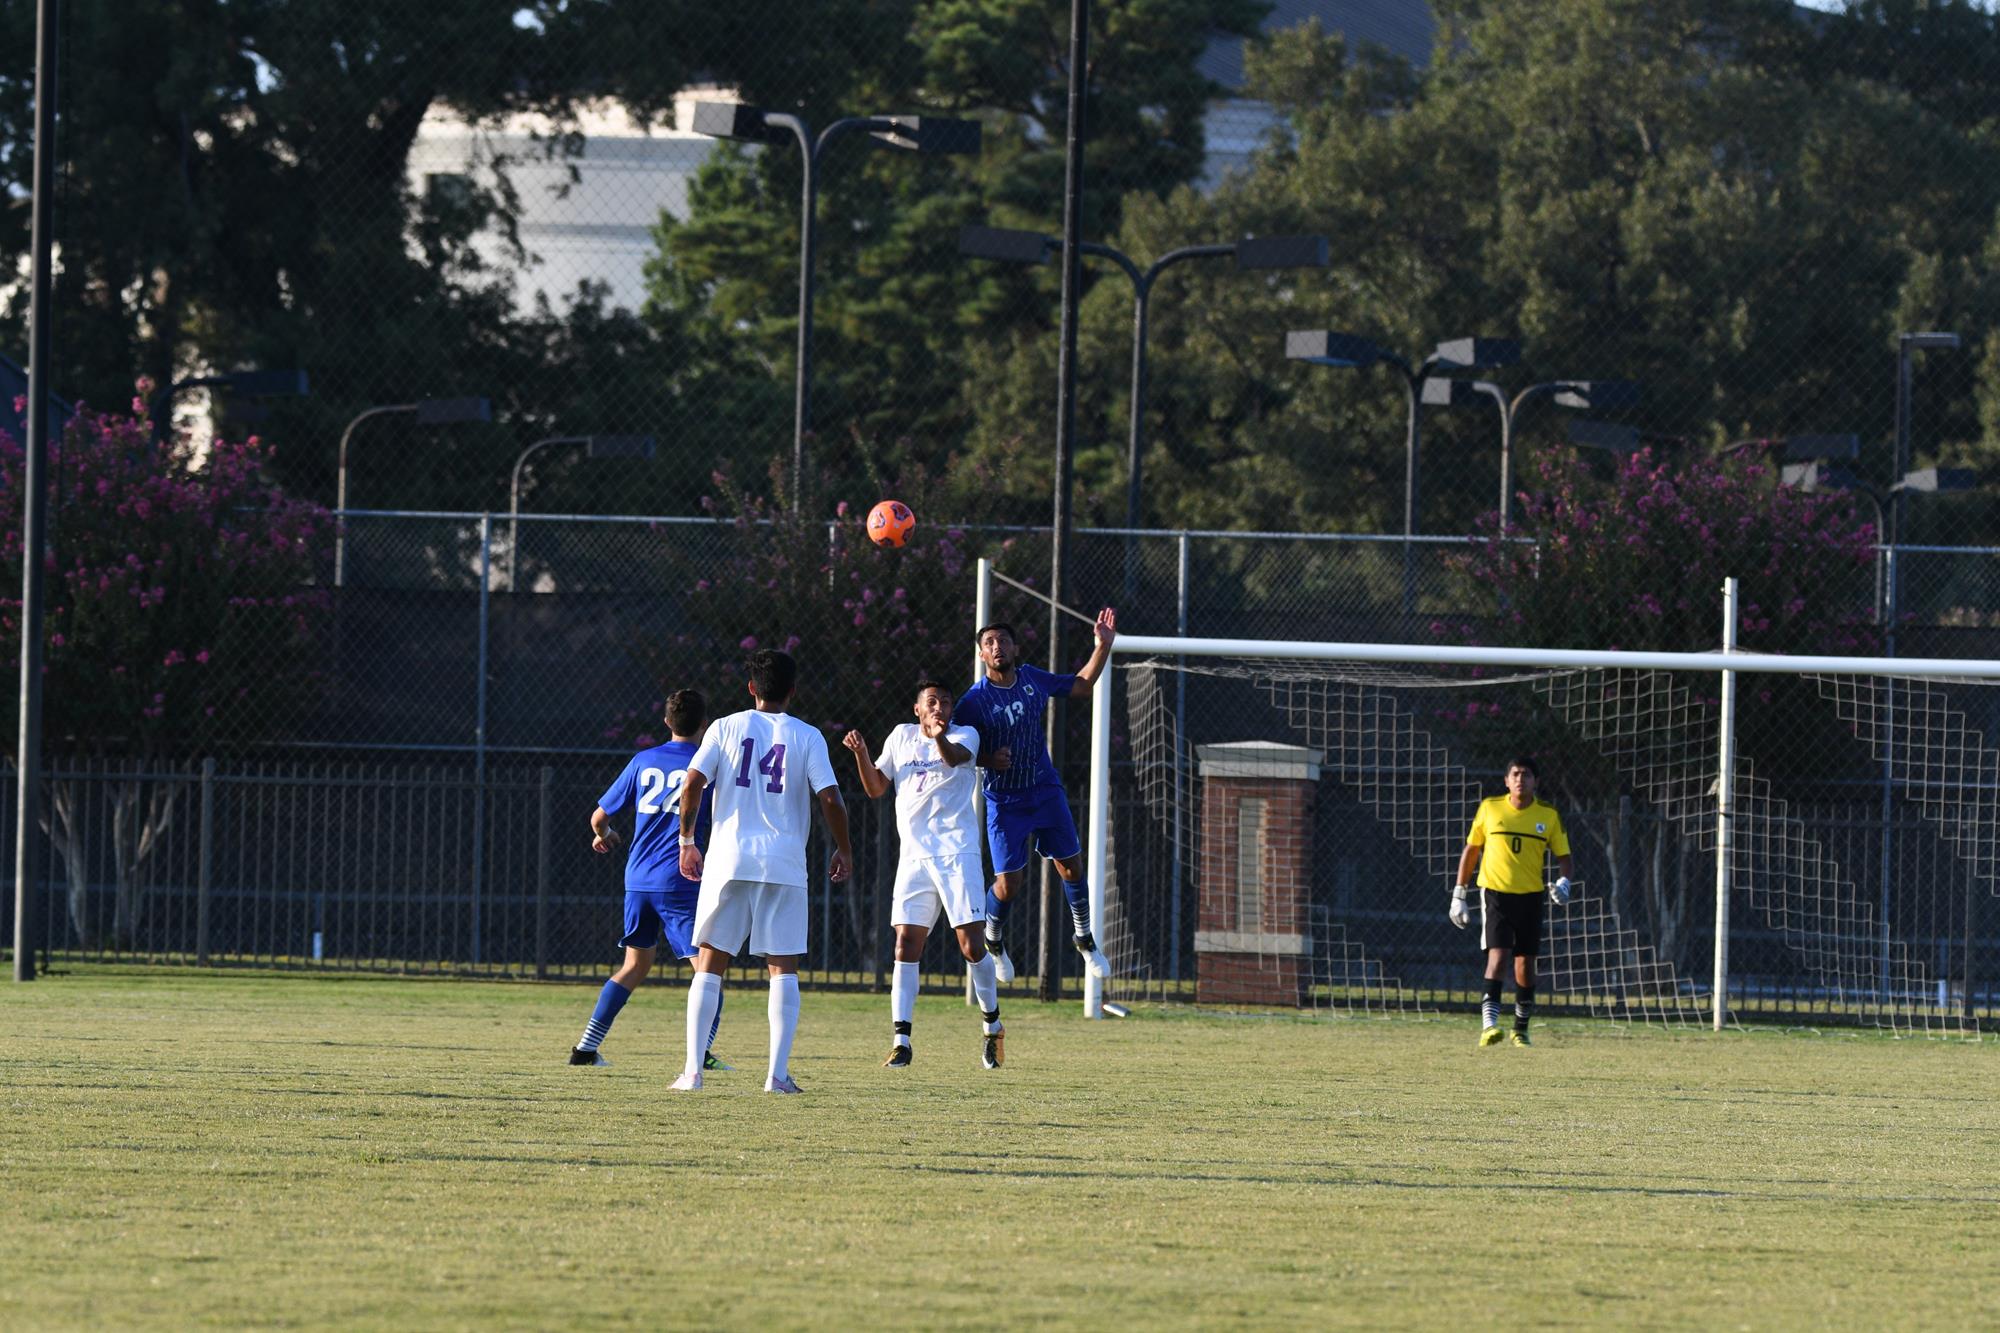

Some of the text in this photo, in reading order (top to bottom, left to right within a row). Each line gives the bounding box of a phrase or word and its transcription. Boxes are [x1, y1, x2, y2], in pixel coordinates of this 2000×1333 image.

[1004, 701, 1024, 727] 13
[735, 737, 786, 793] 14
[638, 767, 688, 815] 22
[916, 770, 928, 792] 7
[1512, 836, 1521, 854] 0
